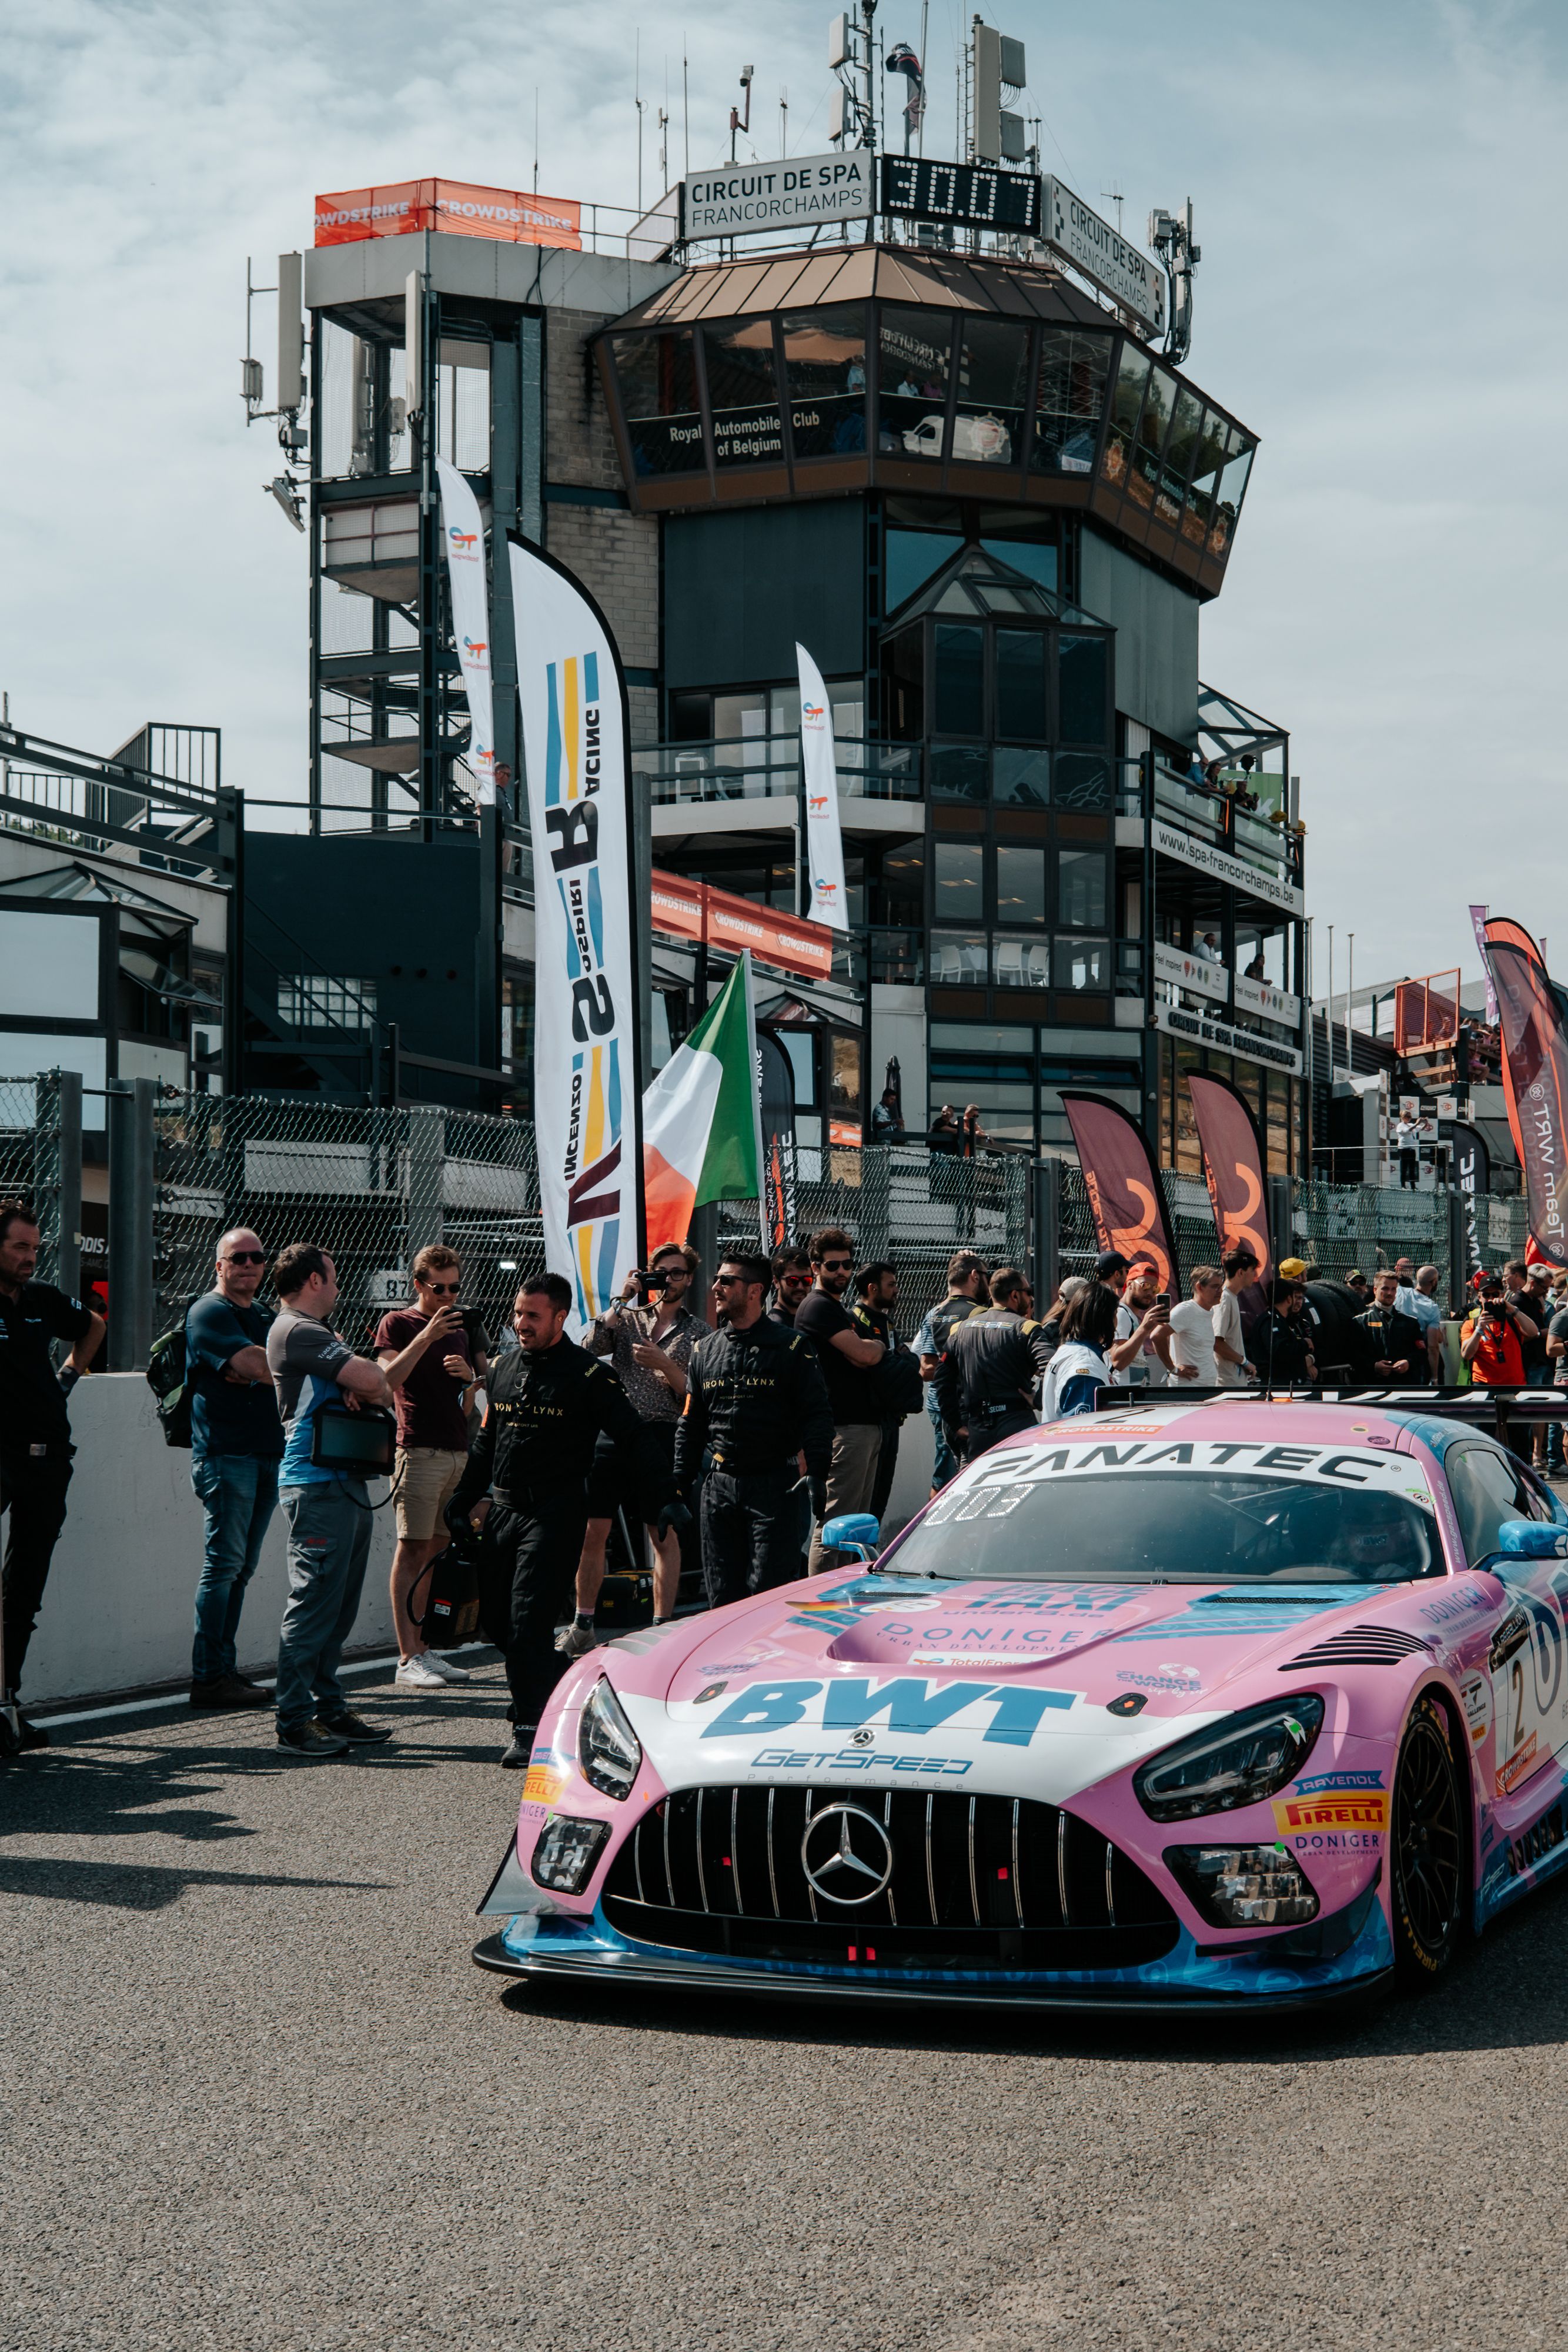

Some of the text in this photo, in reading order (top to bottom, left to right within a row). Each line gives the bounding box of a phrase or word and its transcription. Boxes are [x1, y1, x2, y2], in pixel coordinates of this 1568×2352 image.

[692, 162, 862, 203] CIRCUIT DE SPA
[436, 199, 573, 232] CROWDSTRIKE
[692, 190, 862, 228] FRANCORCHAMPS
[1070, 201, 1147, 288] CIRCUIT DE SPA
[1071, 232, 1148, 314] FRANCORCHAMPS
[670, 411, 820, 444] Royal Automobile Club
[717, 437, 781, 456] of Belgium
[1158, 831, 1294, 904] www.spa-francorchamps.be
[715, 911, 763, 938] CROWDSTRIKE
[778, 933, 824, 958] CROWDSTRIKE
[1155, 953, 1182, 972] Feel inspired
[1235, 984, 1259, 1001] Feel inspired
[1168, 1011, 1296, 1068] CIRCUIT DE SPA FRANCORCHAMPS
[386, 1279, 408, 1299] 87
[789, 1334, 802, 1351] Sabelt
[584, 1362, 600, 1378] Sabelt
[703, 1378, 775, 1390] IRON LYNX
[495, 1402, 563, 1416] RON LYNX
[1051, 1425, 1158, 1435] CROWDSTRIKE
[971, 1443, 1386, 1486] FANATEC
[1436, 1480, 1461, 1565] www.getspeed.de
[989, 1583, 1168, 1595] RACE
[964, 1592, 1141, 1612] TAXI
[942, 1609, 1105, 1618] under8.de
[876, 1631, 939, 1649] URBAN
[882, 1622, 1115, 1643] DONIGER
[1116, 1673, 1201, 1686] CHANGE
[1134, 1680, 1202, 1691] WORLD
[699, 1678, 1077, 1747] BWT
[1500, 1736, 1536, 1785] CROWDSTRIKE
[747, 1773, 963, 1790] Performance
[1302, 1775, 1377, 1790] RAVENOL
[1285, 1798, 1383, 1826] PIRELLI
[1295, 1835, 1379, 1849] DONIGER
